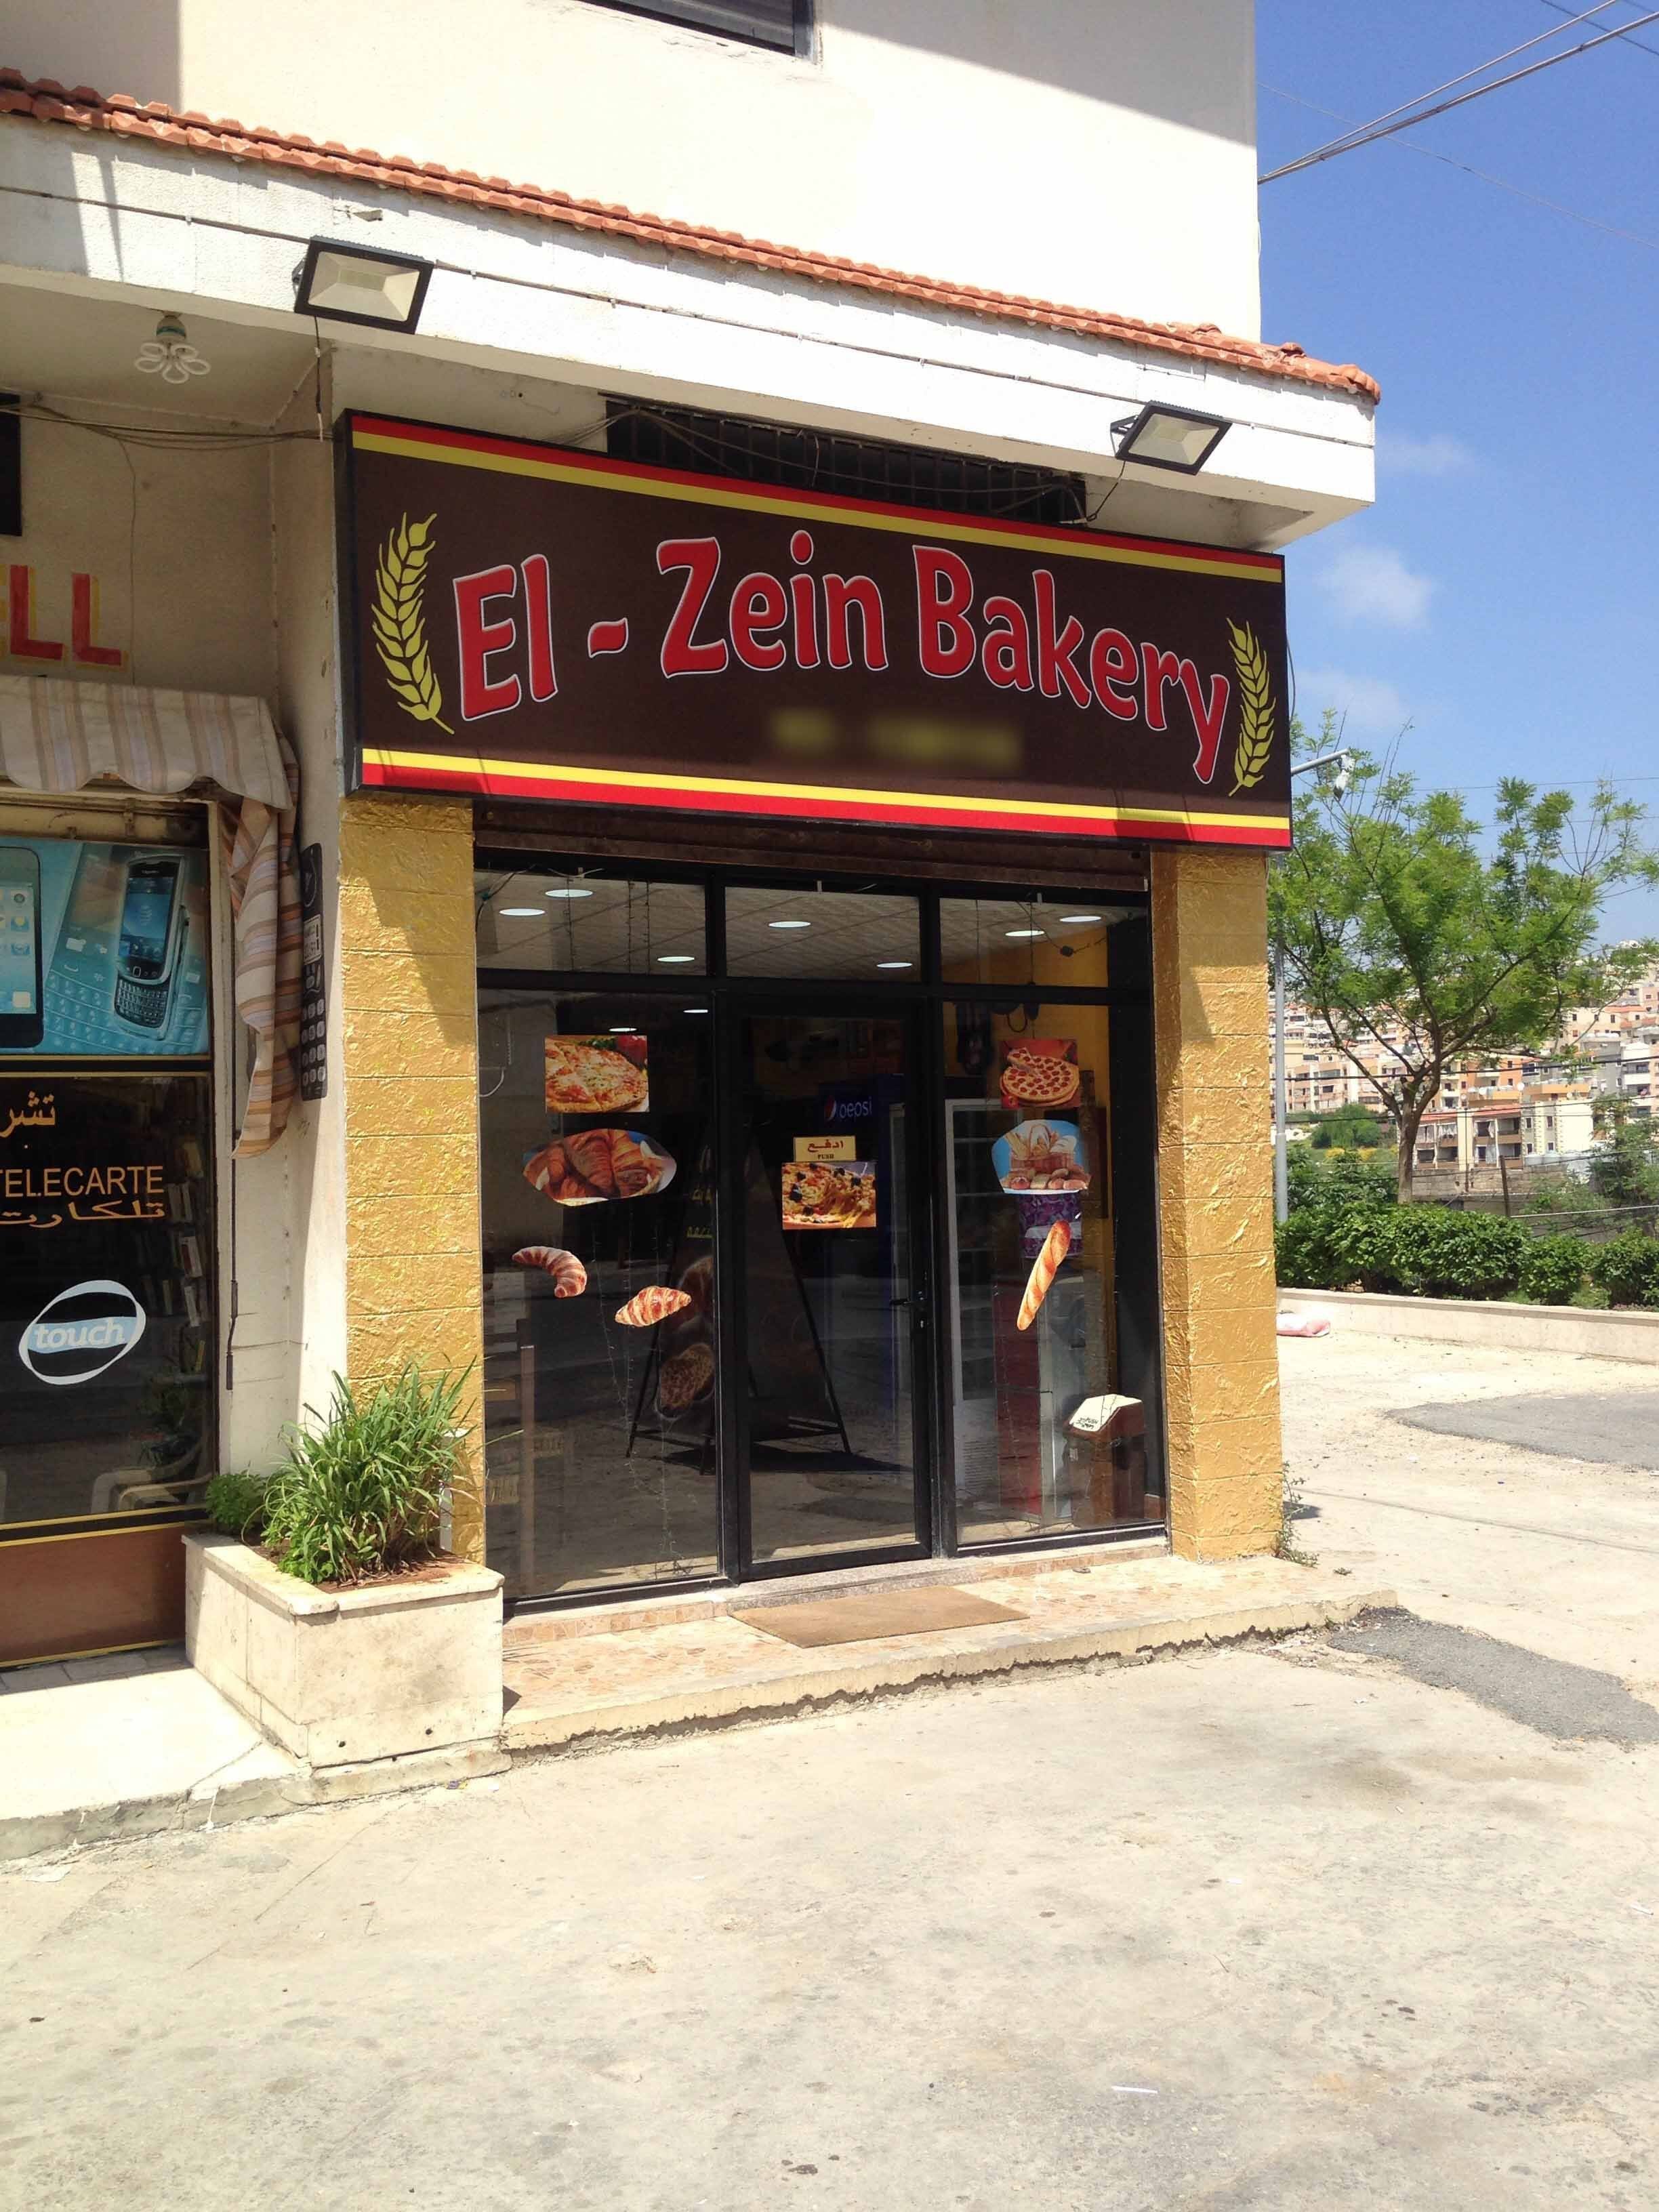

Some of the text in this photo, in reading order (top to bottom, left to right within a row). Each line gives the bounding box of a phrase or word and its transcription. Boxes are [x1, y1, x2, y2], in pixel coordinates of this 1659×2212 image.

[453, 552, 559, 720] El
[656, 529, 887, 676] Zein
[913, 545, 1230, 783] Bakery
[807, 1139, 844, 1153] ادفع
[0, 1166, 165, 1197] ELECARTE
[35, 1317, 125, 1349] touch
